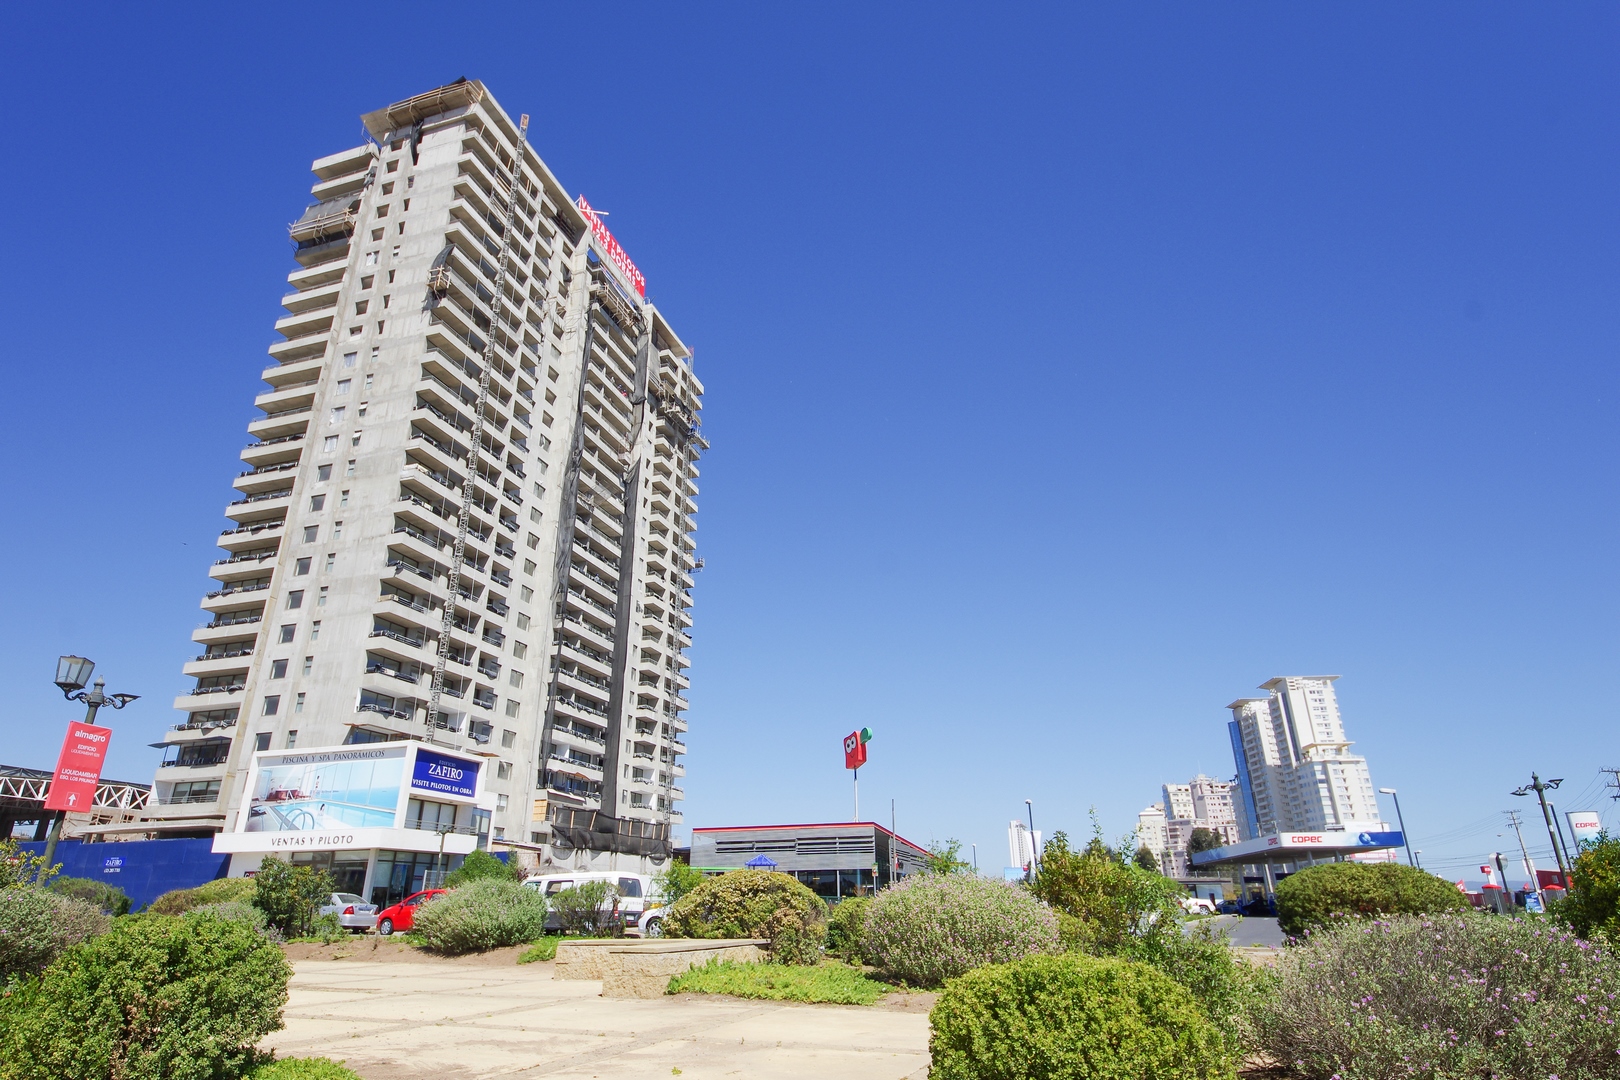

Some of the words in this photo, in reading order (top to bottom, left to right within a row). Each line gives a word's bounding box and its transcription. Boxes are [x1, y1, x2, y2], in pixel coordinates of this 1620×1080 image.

[581, 196, 611, 242] VENTAS
[617, 244, 645, 286] PILOTOS
[610, 247, 636, 286] DORMS
[74, 730, 106, 742] almagro
[282, 756, 309, 764] PISCINA
[318, 754, 331, 762] SPA
[61, 768, 98, 779] LIQUIDAMBAR
[428, 763, 464, 780] ZAFIRO
[412, 779, 430, 788] VISITE
[430, 781, 452, 791] PILOTOS
[452, 785, 460, 793] EN
[271, 837, 306, 847] VENTAS
[309, 836, 316, 845] Y
[318, 834, 354, 845] PILOTO
